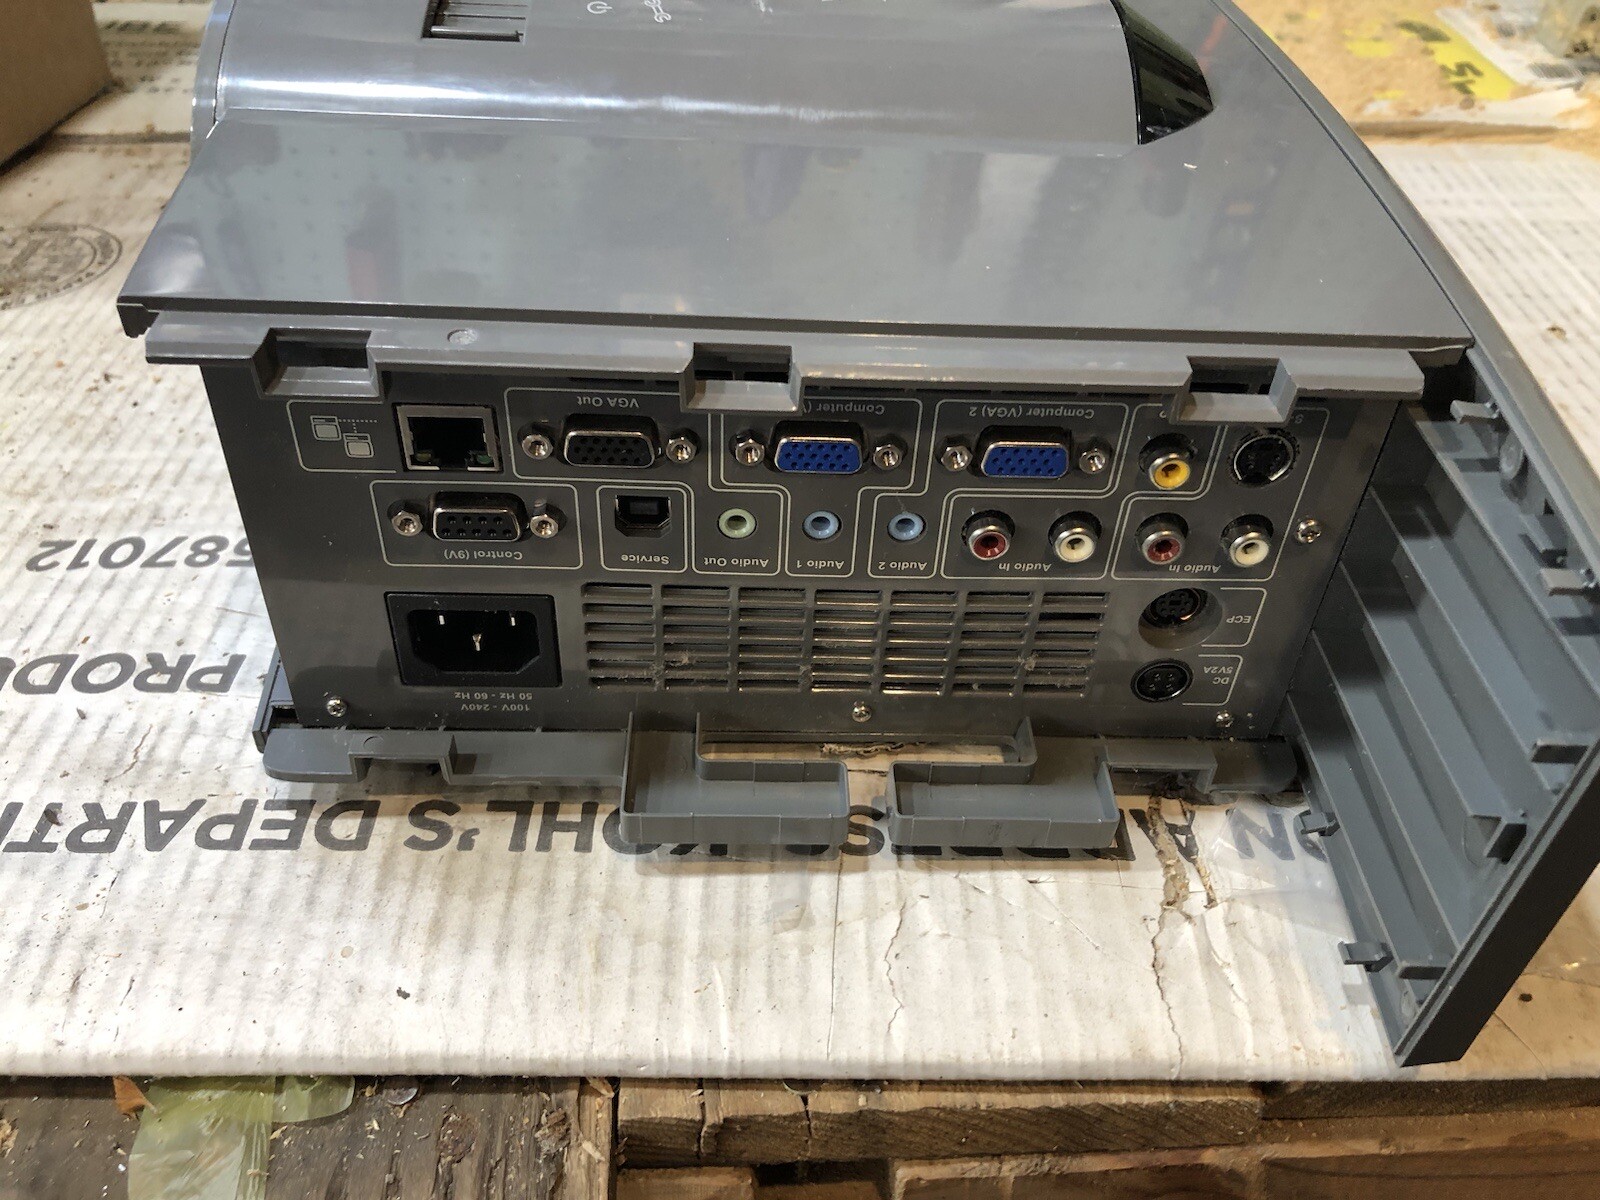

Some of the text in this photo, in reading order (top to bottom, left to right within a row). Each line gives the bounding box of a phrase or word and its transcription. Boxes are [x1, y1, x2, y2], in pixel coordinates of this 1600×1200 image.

[576, 394, 639, 408] VGA Out
[816, 402, 885, 415] Computer
[968, 404, 1095, 419] Computer (VGA) 2
[443, 547, 523, 561] Control (9V)
[620, 553, 670, 565] Service
[703, 555, 769, 568] Audio Out
[796, 559, 845, 570] Audio 1
[878, 560, 928, 571] Audio 2
[998, 562, 1052, 573] Audio In
[1168, 564, 1221, 574] Audio In
[1226, 614, 1252, 624] ECP
[1212, 676, 1230, 685] DC
[454, 691, 470, 700] Hz
[474, 691, 489, 700] 60
[500, 692, 516, 700] Hz
[519, 692, 533, 700] 50
[460, 703, 490, 711] 240V
[501, 703, 531, 711] 100V
